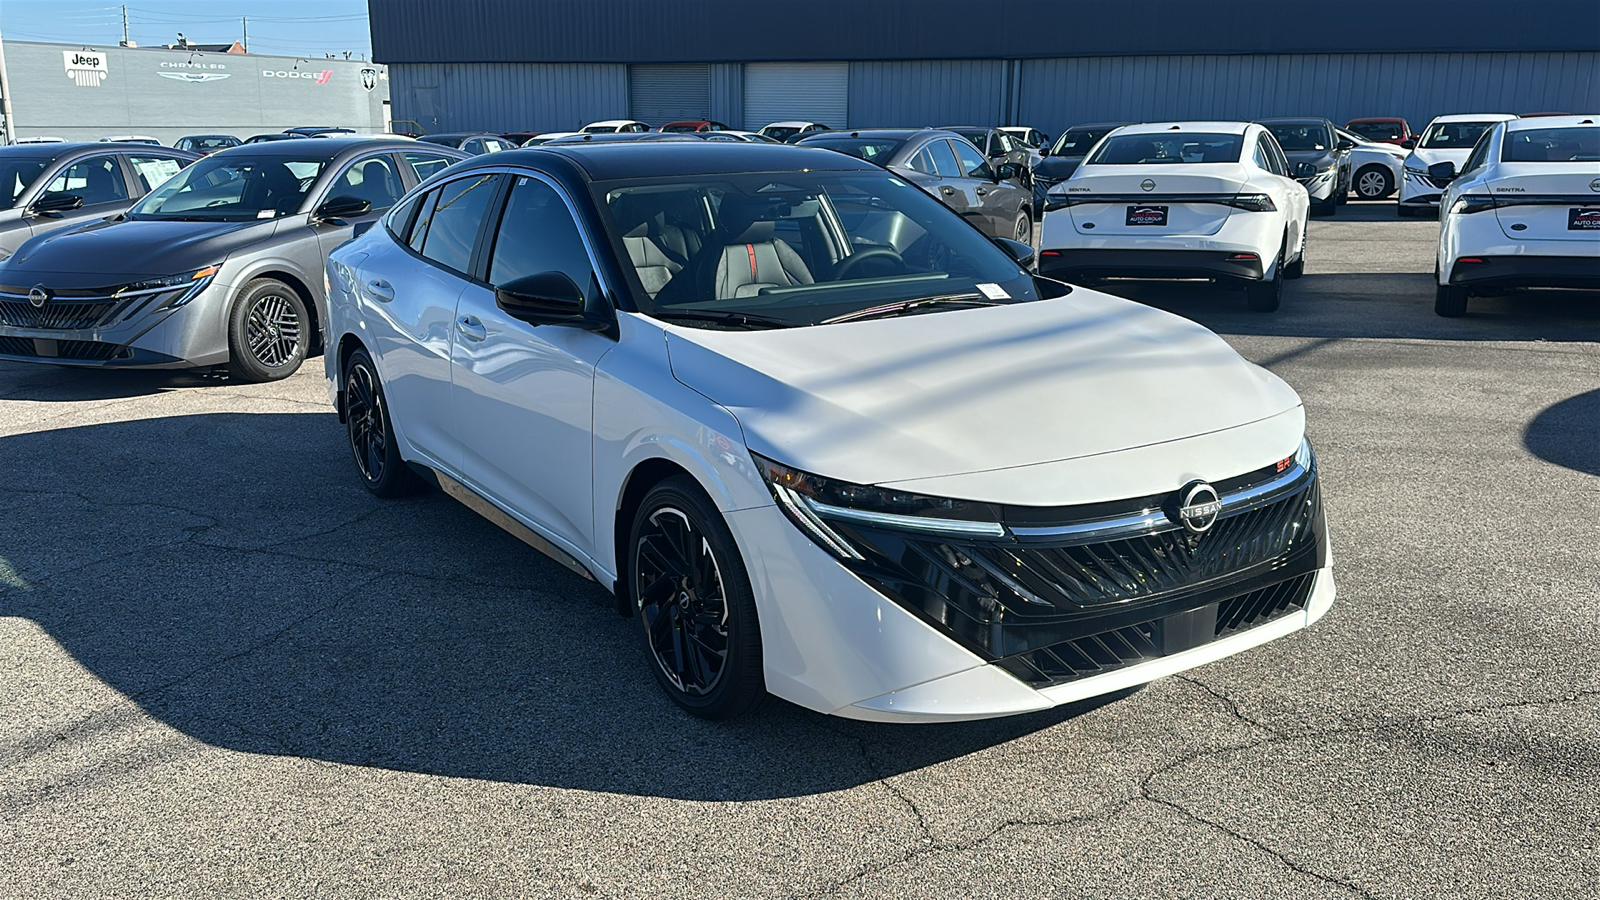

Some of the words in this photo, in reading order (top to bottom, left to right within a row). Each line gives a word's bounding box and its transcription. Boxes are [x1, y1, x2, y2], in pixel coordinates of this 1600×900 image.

[72, 54, 99, 68] Jeep
[263, 70, 324, 79] DODGE
[1276, 457, 1290, 473] SR
[1180, 501, 1222, 519] NISSAN
